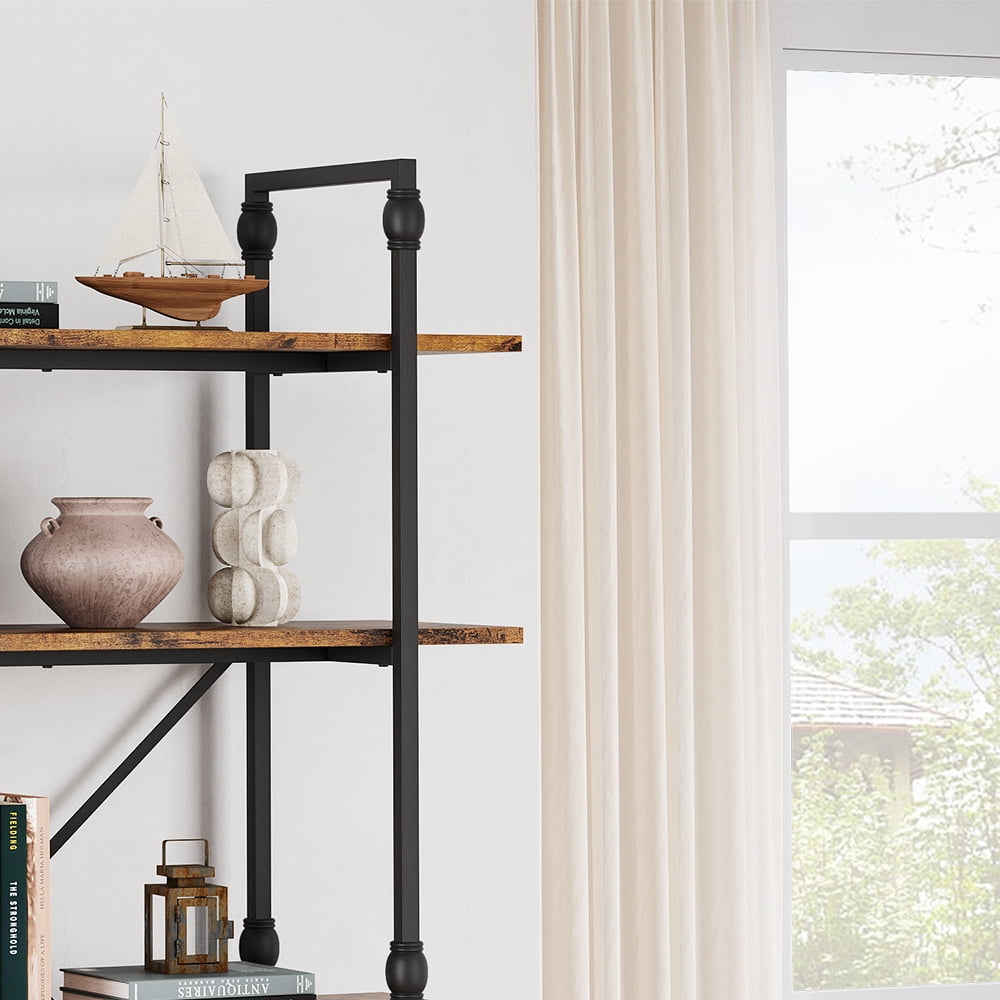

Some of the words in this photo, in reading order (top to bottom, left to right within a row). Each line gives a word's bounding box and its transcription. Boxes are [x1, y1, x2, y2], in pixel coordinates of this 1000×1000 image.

[16, 307, 40, 316] Virginia
[15, 317, 22, 325] in
[23, 317, 40, 326] Detail
[10, 812, 18, 850] FIELDING
[10, 881, 18, 897] THE
[10, 900, 18, 956] STRONGHOLD
[177, 983, 269, 998] ANTIQUAIRES
